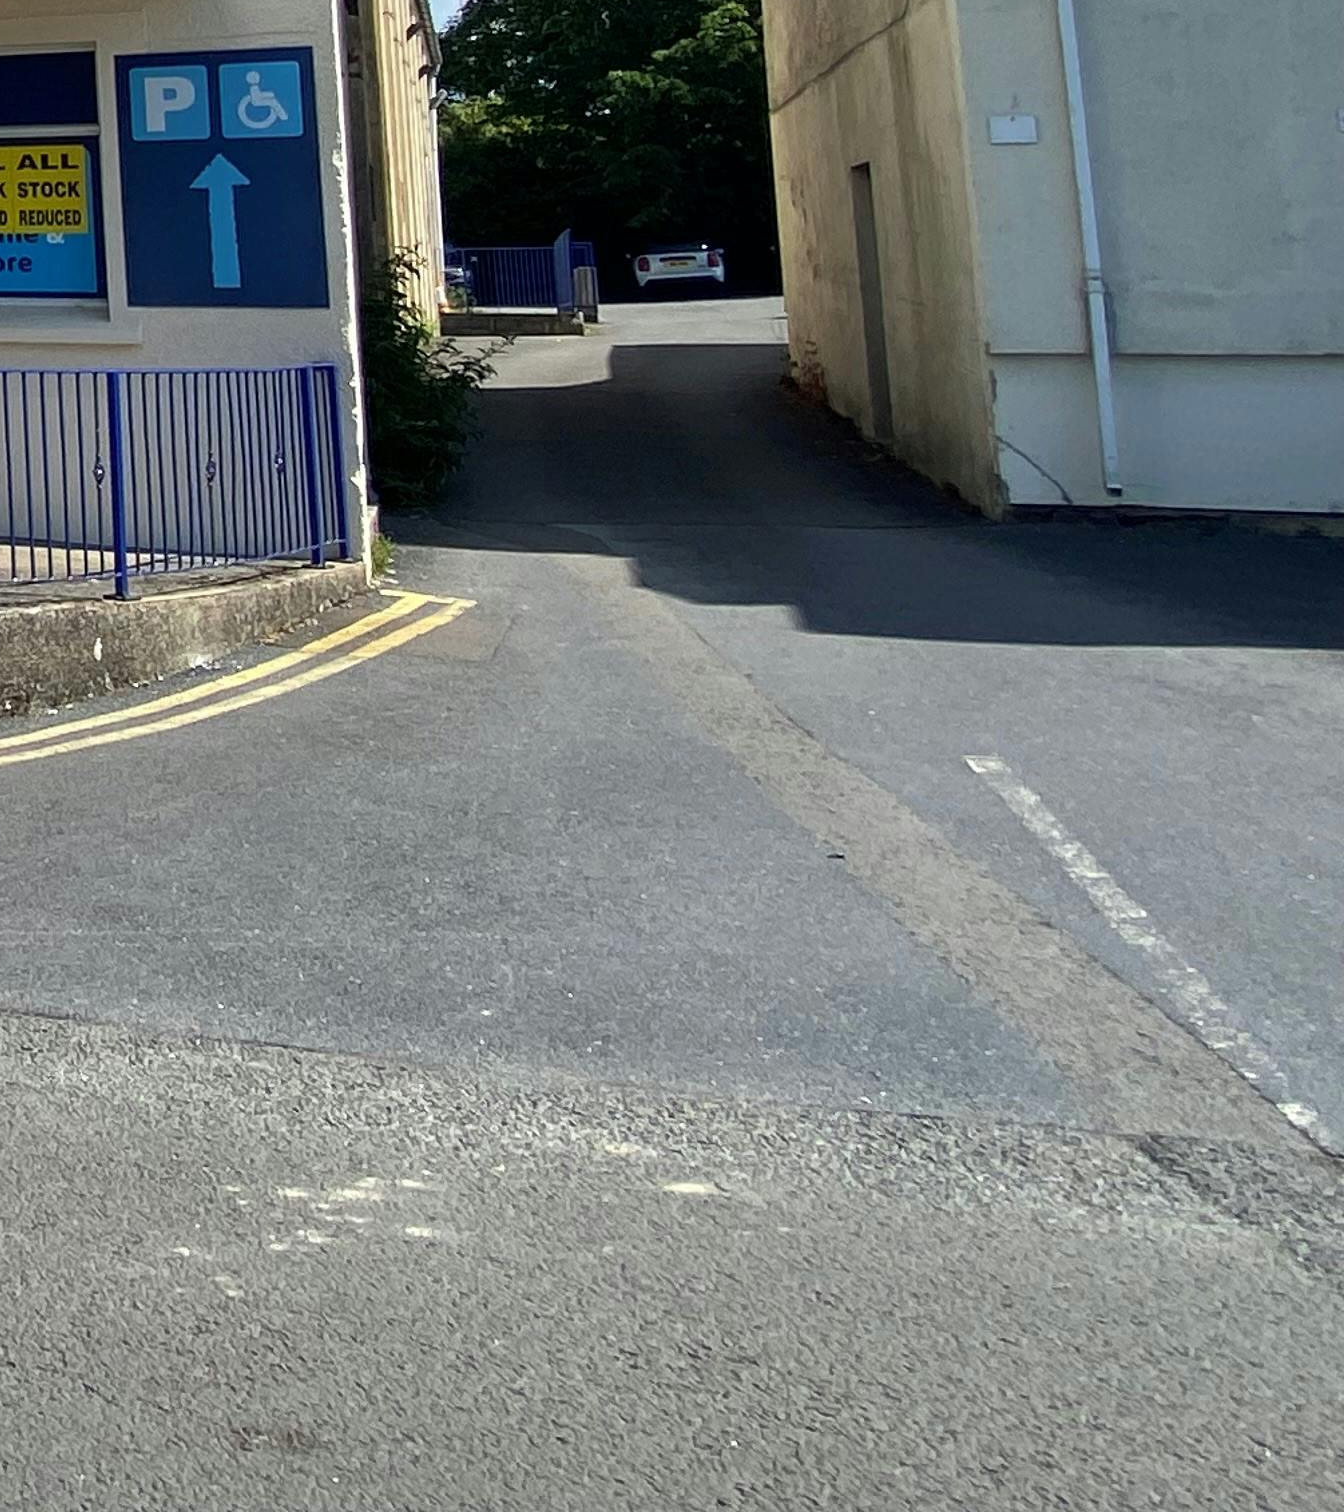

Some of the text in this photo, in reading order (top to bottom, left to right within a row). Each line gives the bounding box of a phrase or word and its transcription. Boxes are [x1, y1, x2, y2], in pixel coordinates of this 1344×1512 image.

[144, 75, 196, 133] P
[16, 153, 79, 170] ALL
[17, 181, 81, 198] STOCK
[19, 209, 82, 226] REDUCED
